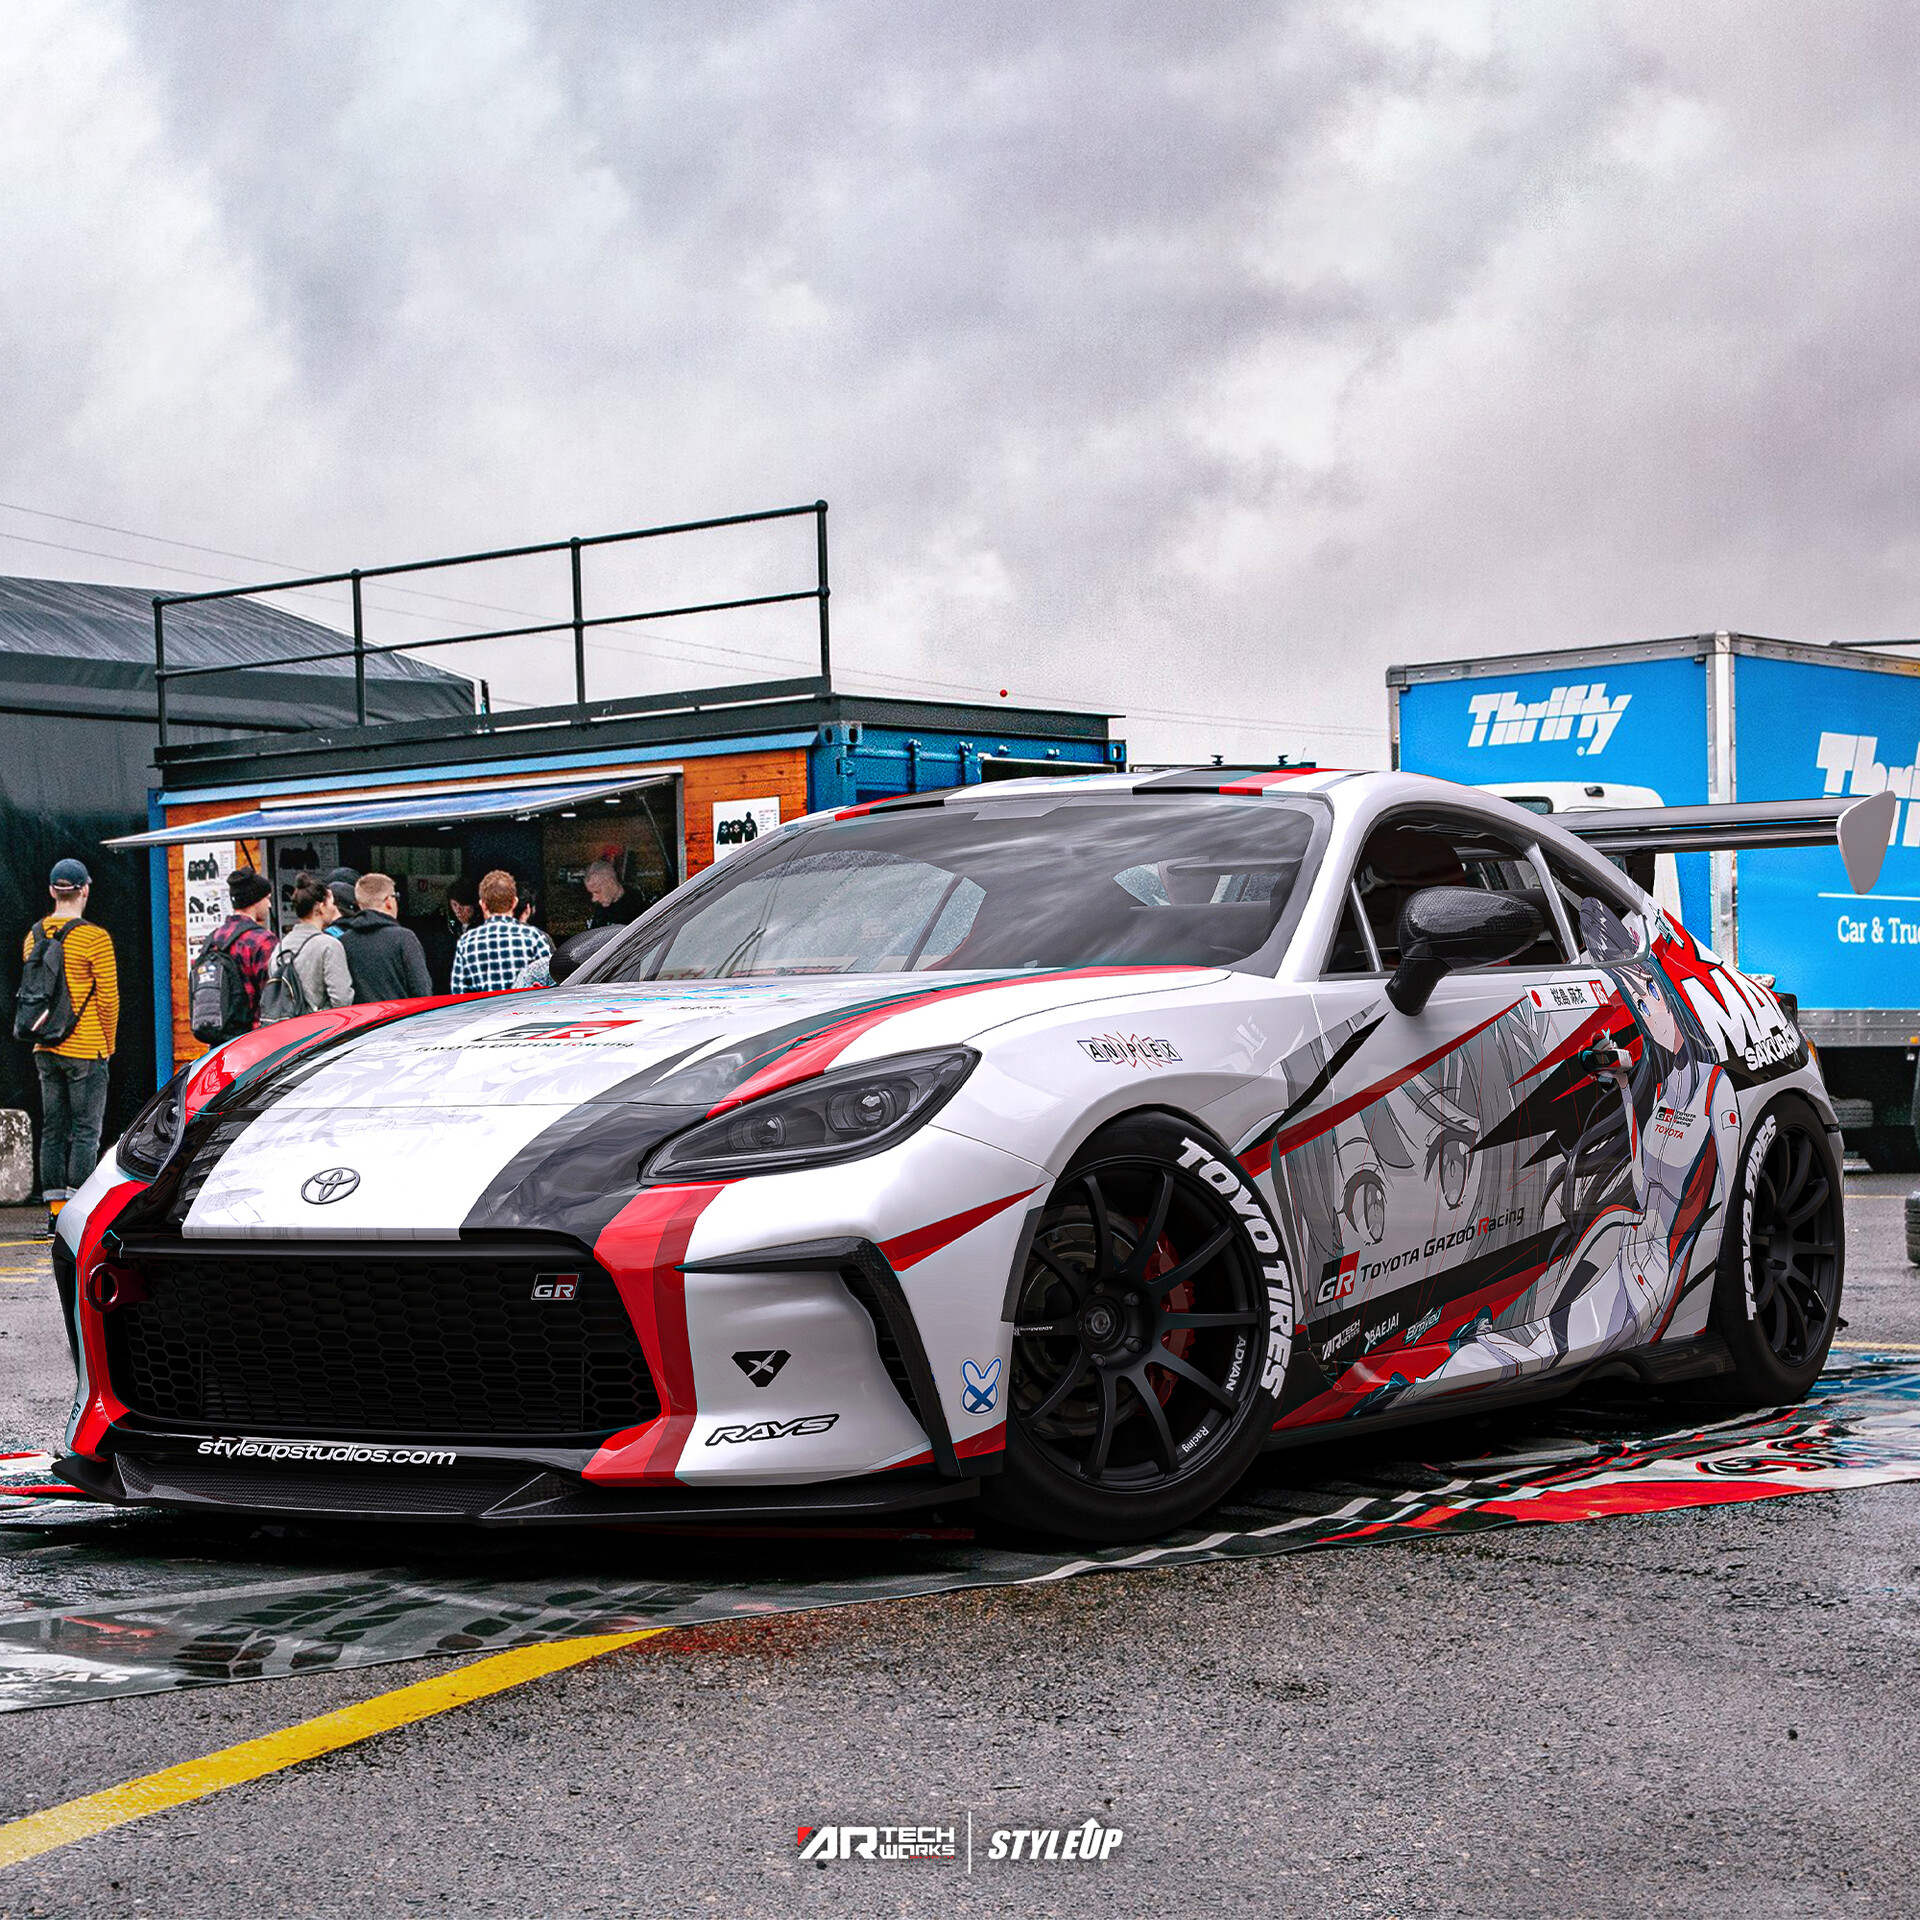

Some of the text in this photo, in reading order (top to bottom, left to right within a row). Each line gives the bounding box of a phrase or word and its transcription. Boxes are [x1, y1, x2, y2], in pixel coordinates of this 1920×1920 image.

[1467, 683, 1633, 756] Thrifty
[1838, 916, 1867, 943] Car
[1871, 917, 1884, 944] &
[1088, 1042, 1178, 1060] ANIPLEX
[1655, 1124, 1684, 1140] TOYOTA
[1176, 1136, 1295, 1399] TOYO TIRES
[1318, 1206, 1525, 1303] GR TOYOTA GAZOO Racing
[534, 1283, 575, 1298] GR
[1341, 1319, 1361, 1337] TECH
[1225, 1335, 1247, 1392] ADVAN
[705, 1413, 840, 1446] RAYS
[1182, 1424, 1209, 1454] Racing
[197, 1438, 457, 1466] styleupstudios.com
